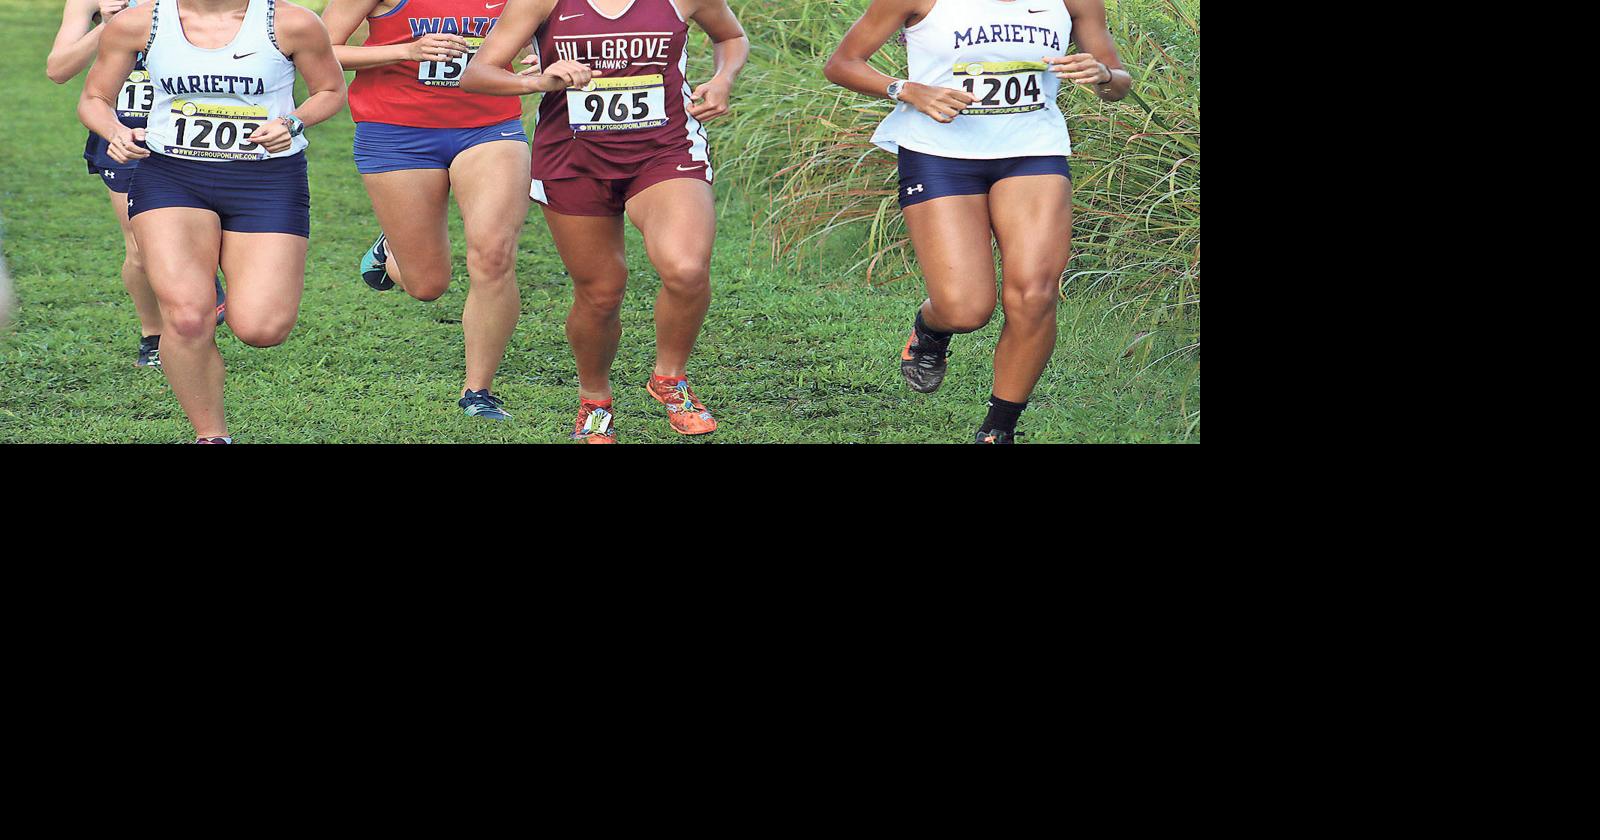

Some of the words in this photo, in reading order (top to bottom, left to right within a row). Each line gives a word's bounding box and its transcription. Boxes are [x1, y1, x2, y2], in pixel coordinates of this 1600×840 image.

[555, 37, 671, 61] HILLGROVE
[953, 24, 1060, 51] MARIETTA
[595, 60, 628, 69] HAWKS
[160, 74, 265, 95] MARIETTA
[962, 74, 1040, 106] 1204
[584, 92, 649, 122] 965
[174, 117, 262, 151] 1203
[178, 148, 257, 160] WWW.PTGROUPONLINE.COM
